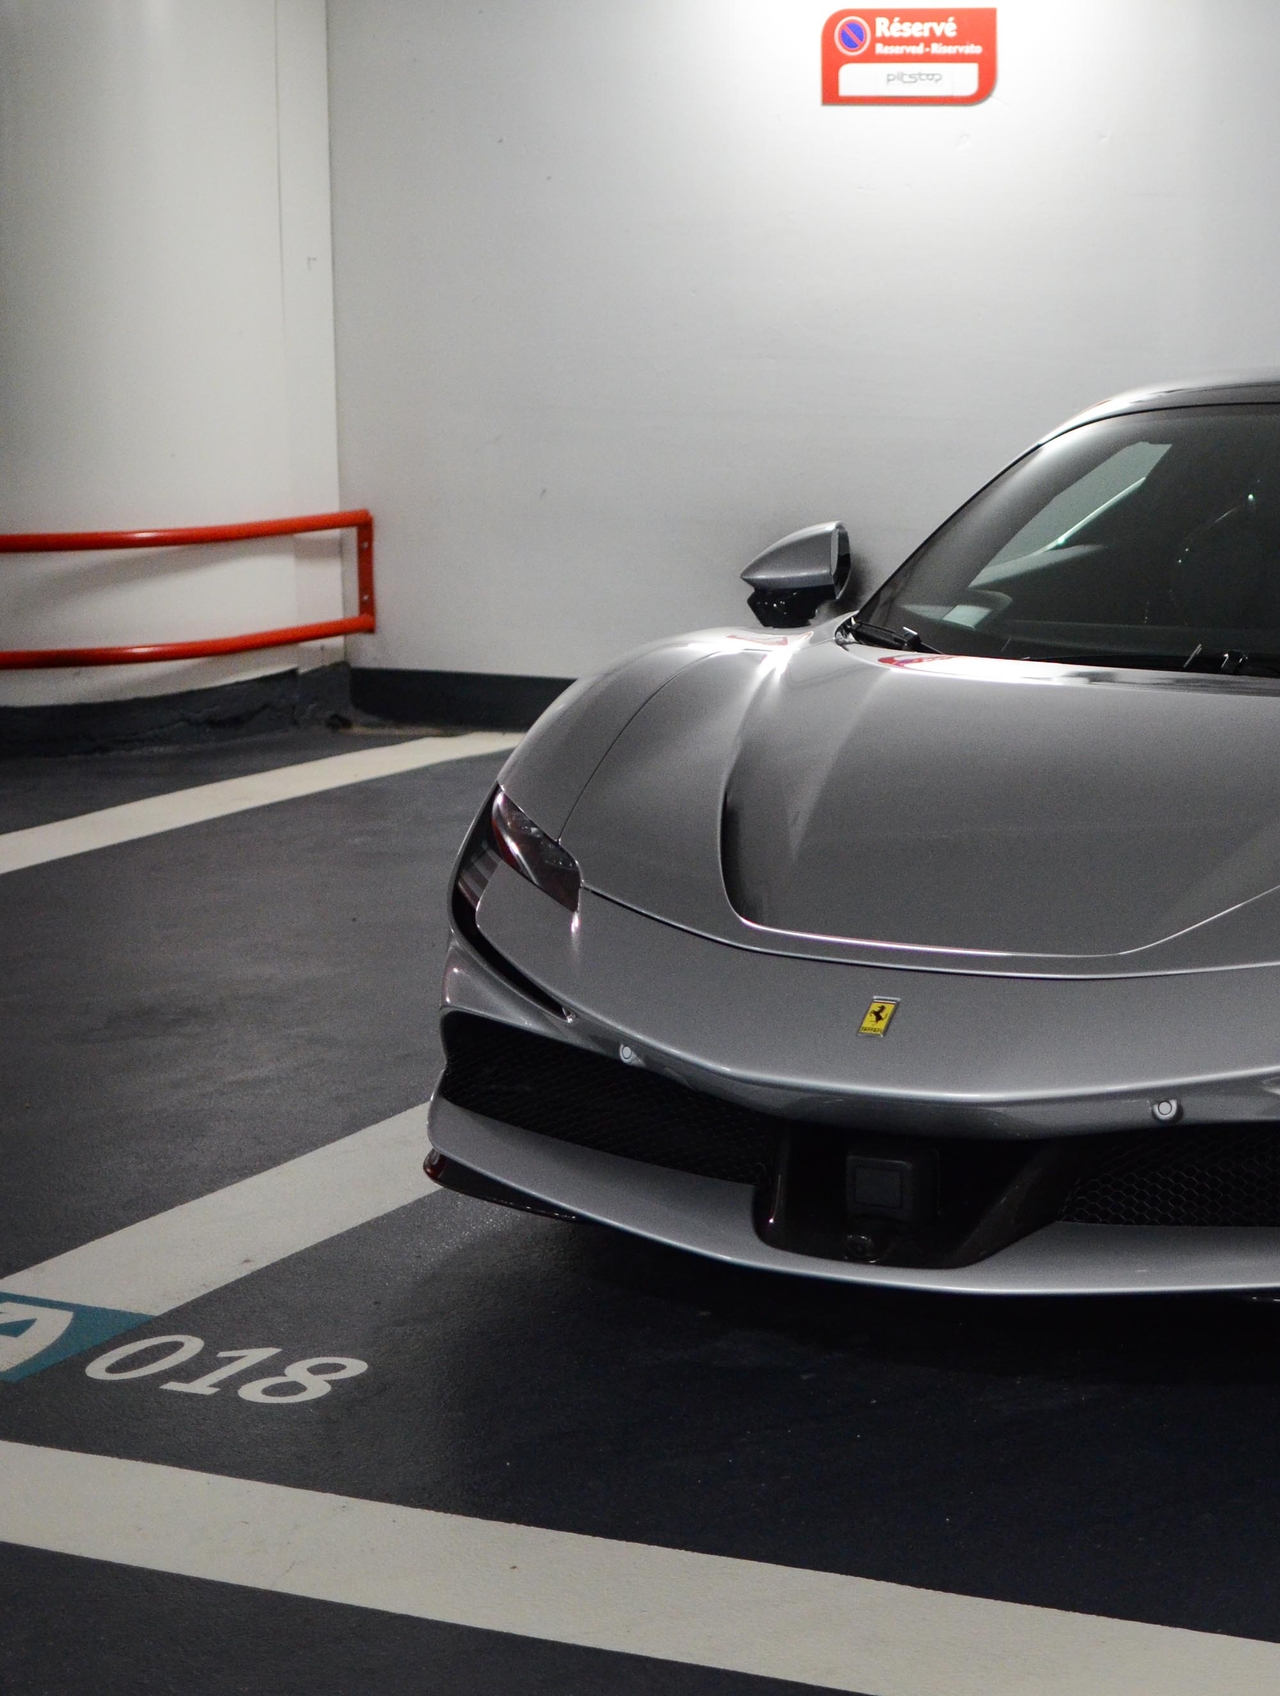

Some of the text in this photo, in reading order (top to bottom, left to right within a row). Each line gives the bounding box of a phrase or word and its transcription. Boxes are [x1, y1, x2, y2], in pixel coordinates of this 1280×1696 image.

[875, 17, 957, 37] Réservé
[875, 42, 924, 54] Reserved
[931, 43, 983, 54] Riservato
[85, 1334, 368, 1404] 018
